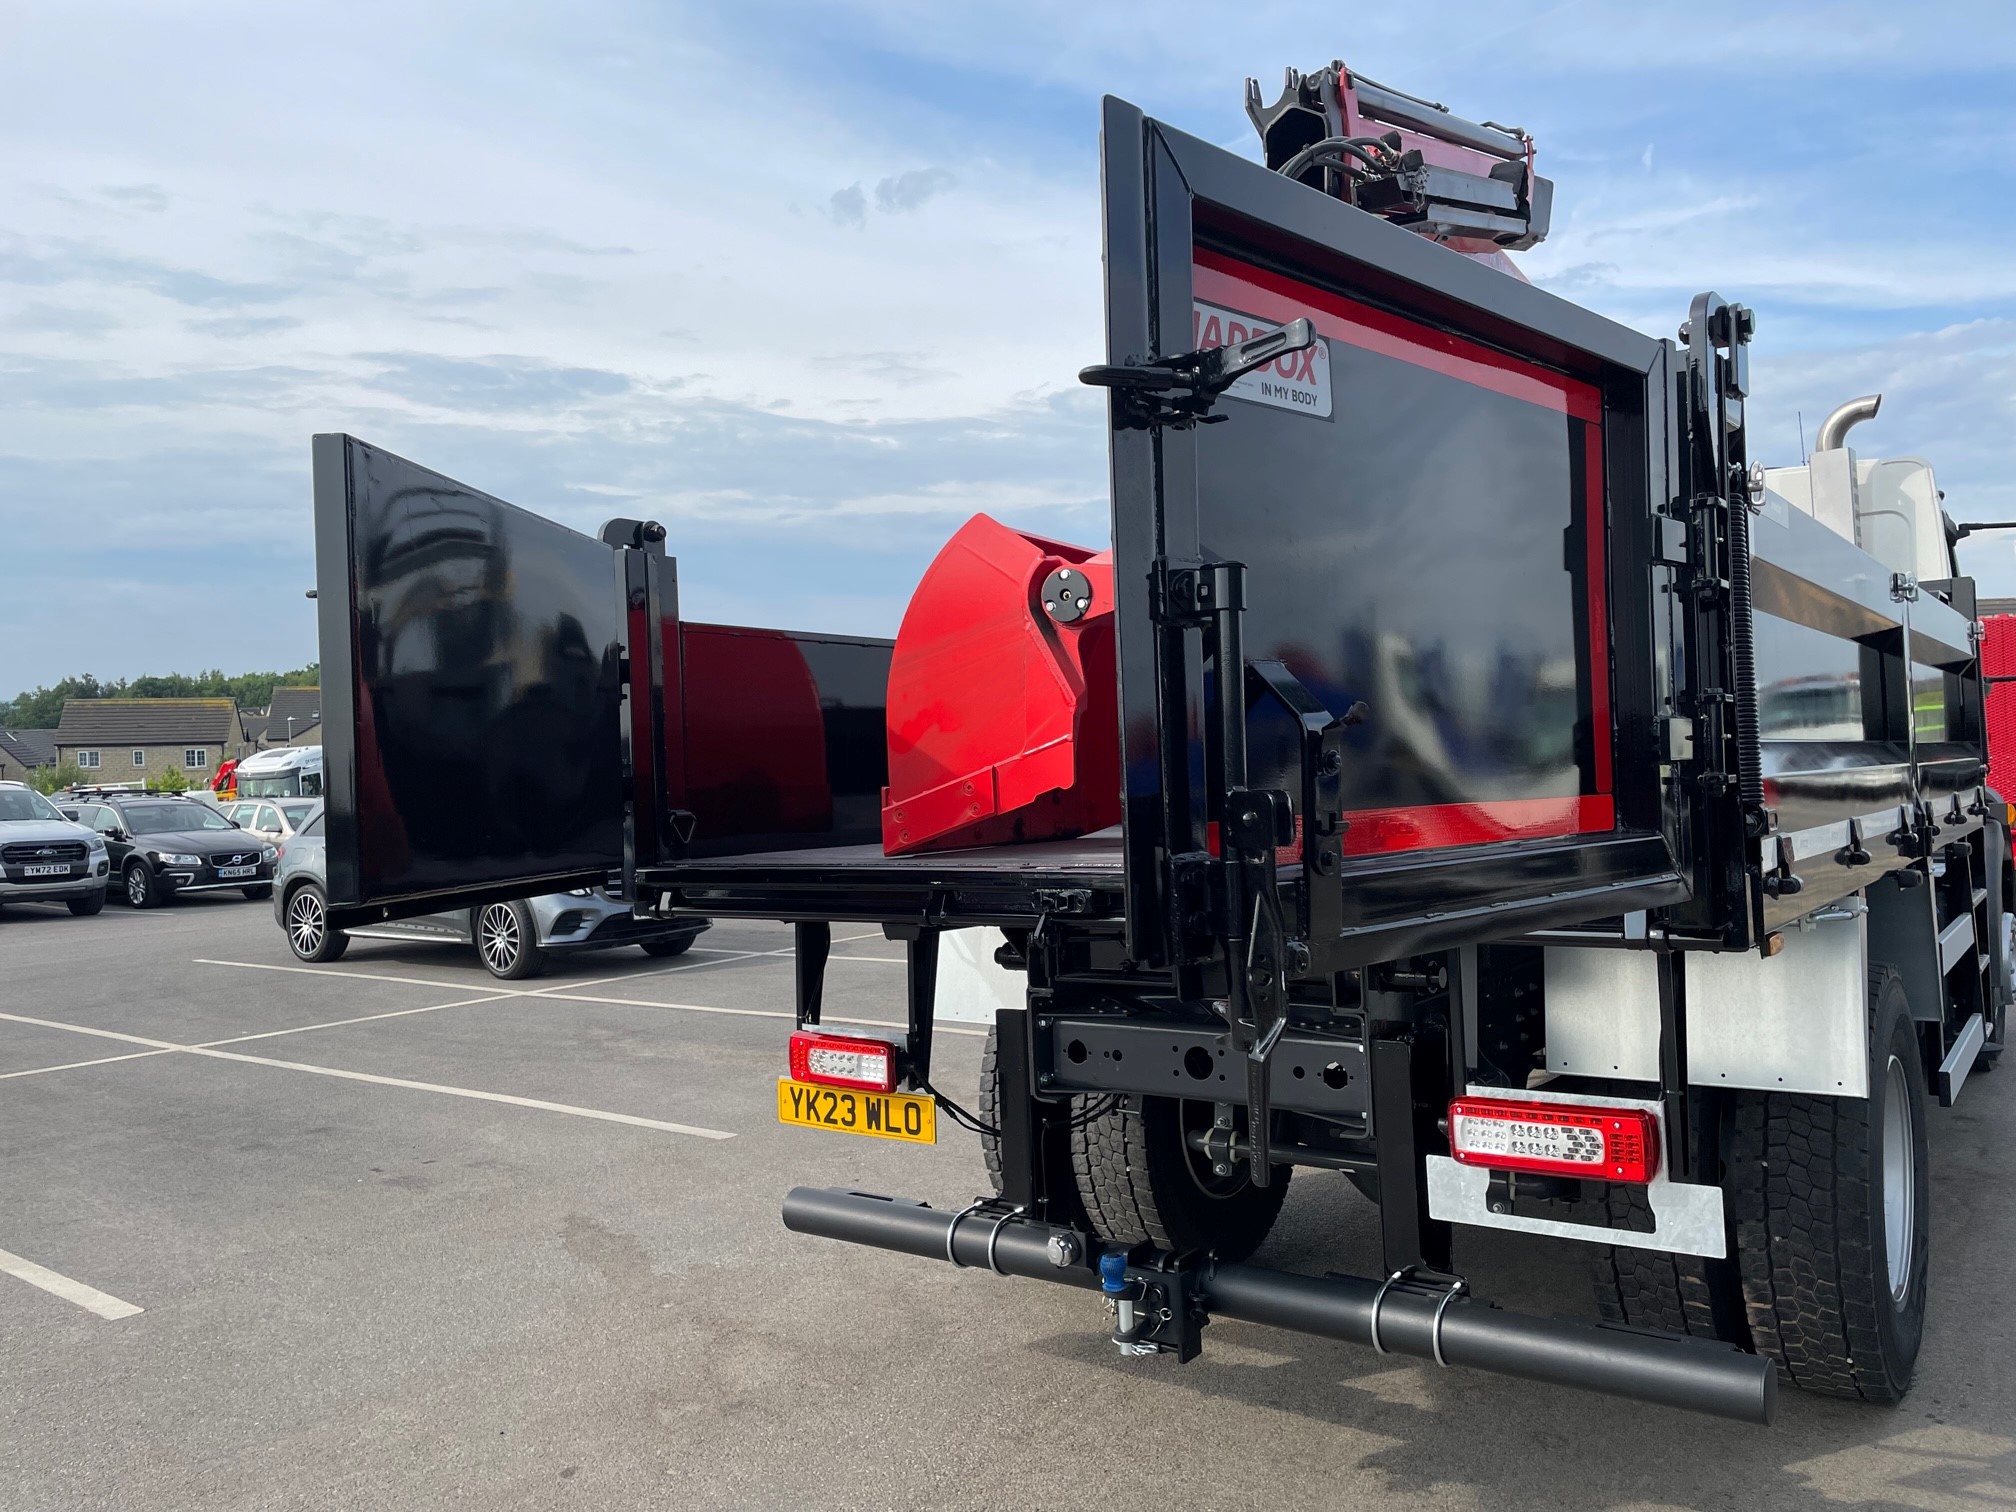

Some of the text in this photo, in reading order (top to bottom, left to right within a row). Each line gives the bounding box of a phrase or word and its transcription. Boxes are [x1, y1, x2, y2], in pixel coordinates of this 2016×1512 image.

[1261, 381, 1272, 396] IN
[1274, 384, 1289, 400] MY
[1291, 389, 1318, 407] BODY
[53, 864, 69, 873] EDK
[223, 867, 255, 877] KN65 HRL
[789, 1086, 922, 1136] YK23 WLO
